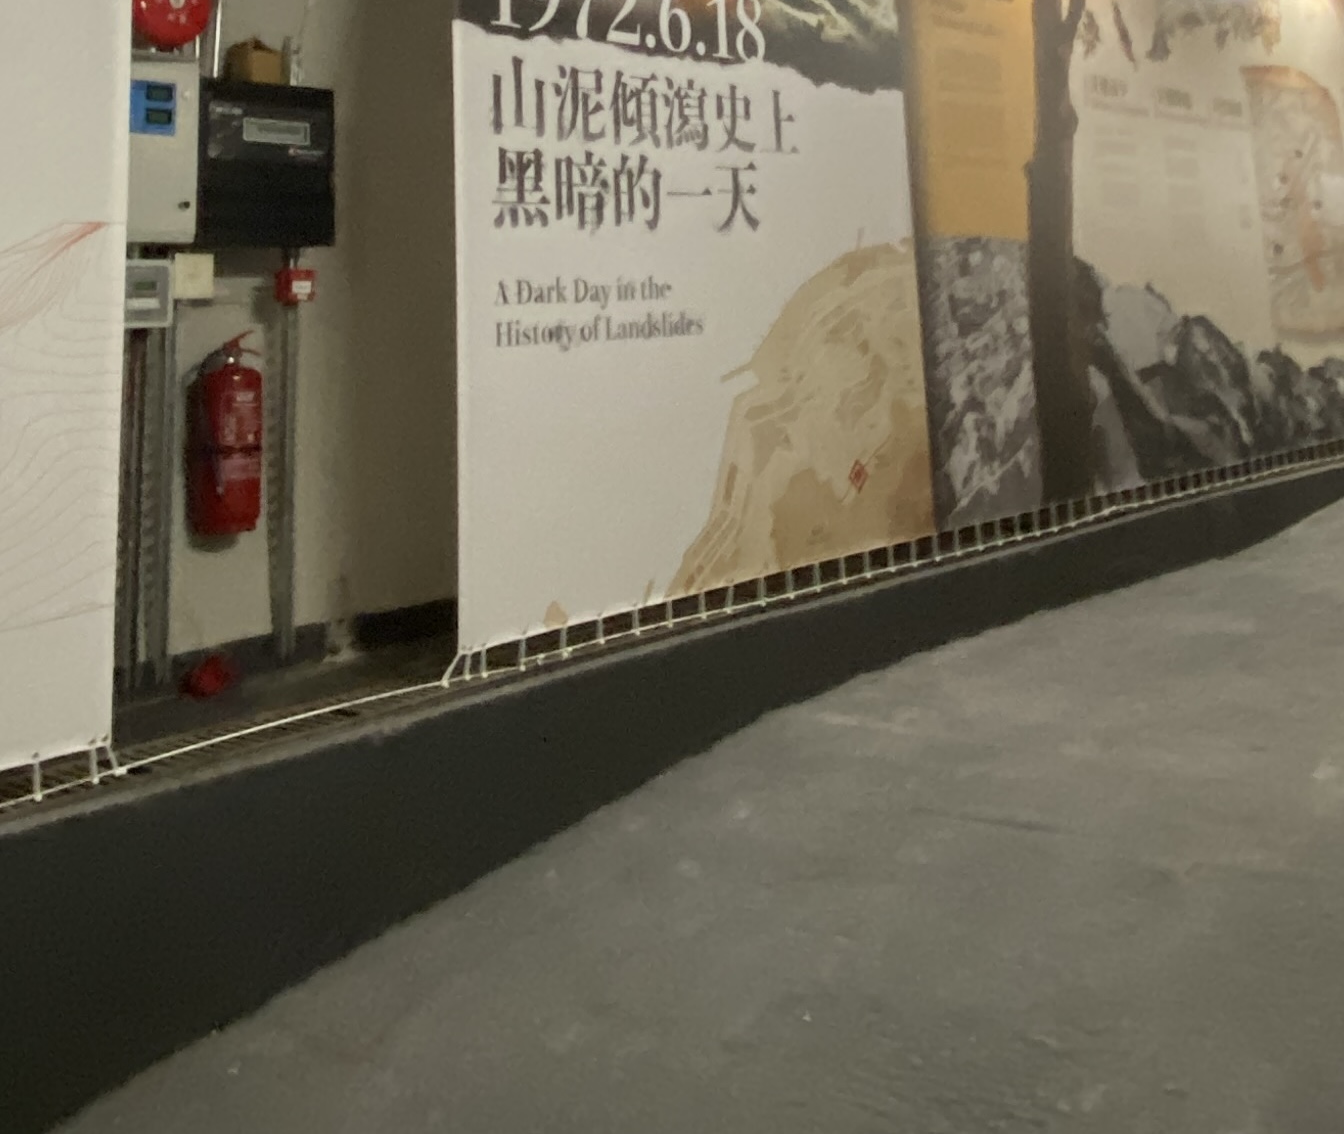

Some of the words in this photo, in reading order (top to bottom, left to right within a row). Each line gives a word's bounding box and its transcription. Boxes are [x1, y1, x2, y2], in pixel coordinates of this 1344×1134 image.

[490, 54, 801, 155] 山泥傾瀉史上
[491, 146, 760, 234] 黑暗的一天
[494, 280, 510, 306] A
[516, 277, 567, 305] Dark
[573, 277, 611, 311] Day
[616, 276, 637, 302] in
[640, 275, 673, 302] the
[495, 319, 576, 353] History
[579, 314, 601, 343] of
[606, 311, 705, 341] Landslides
